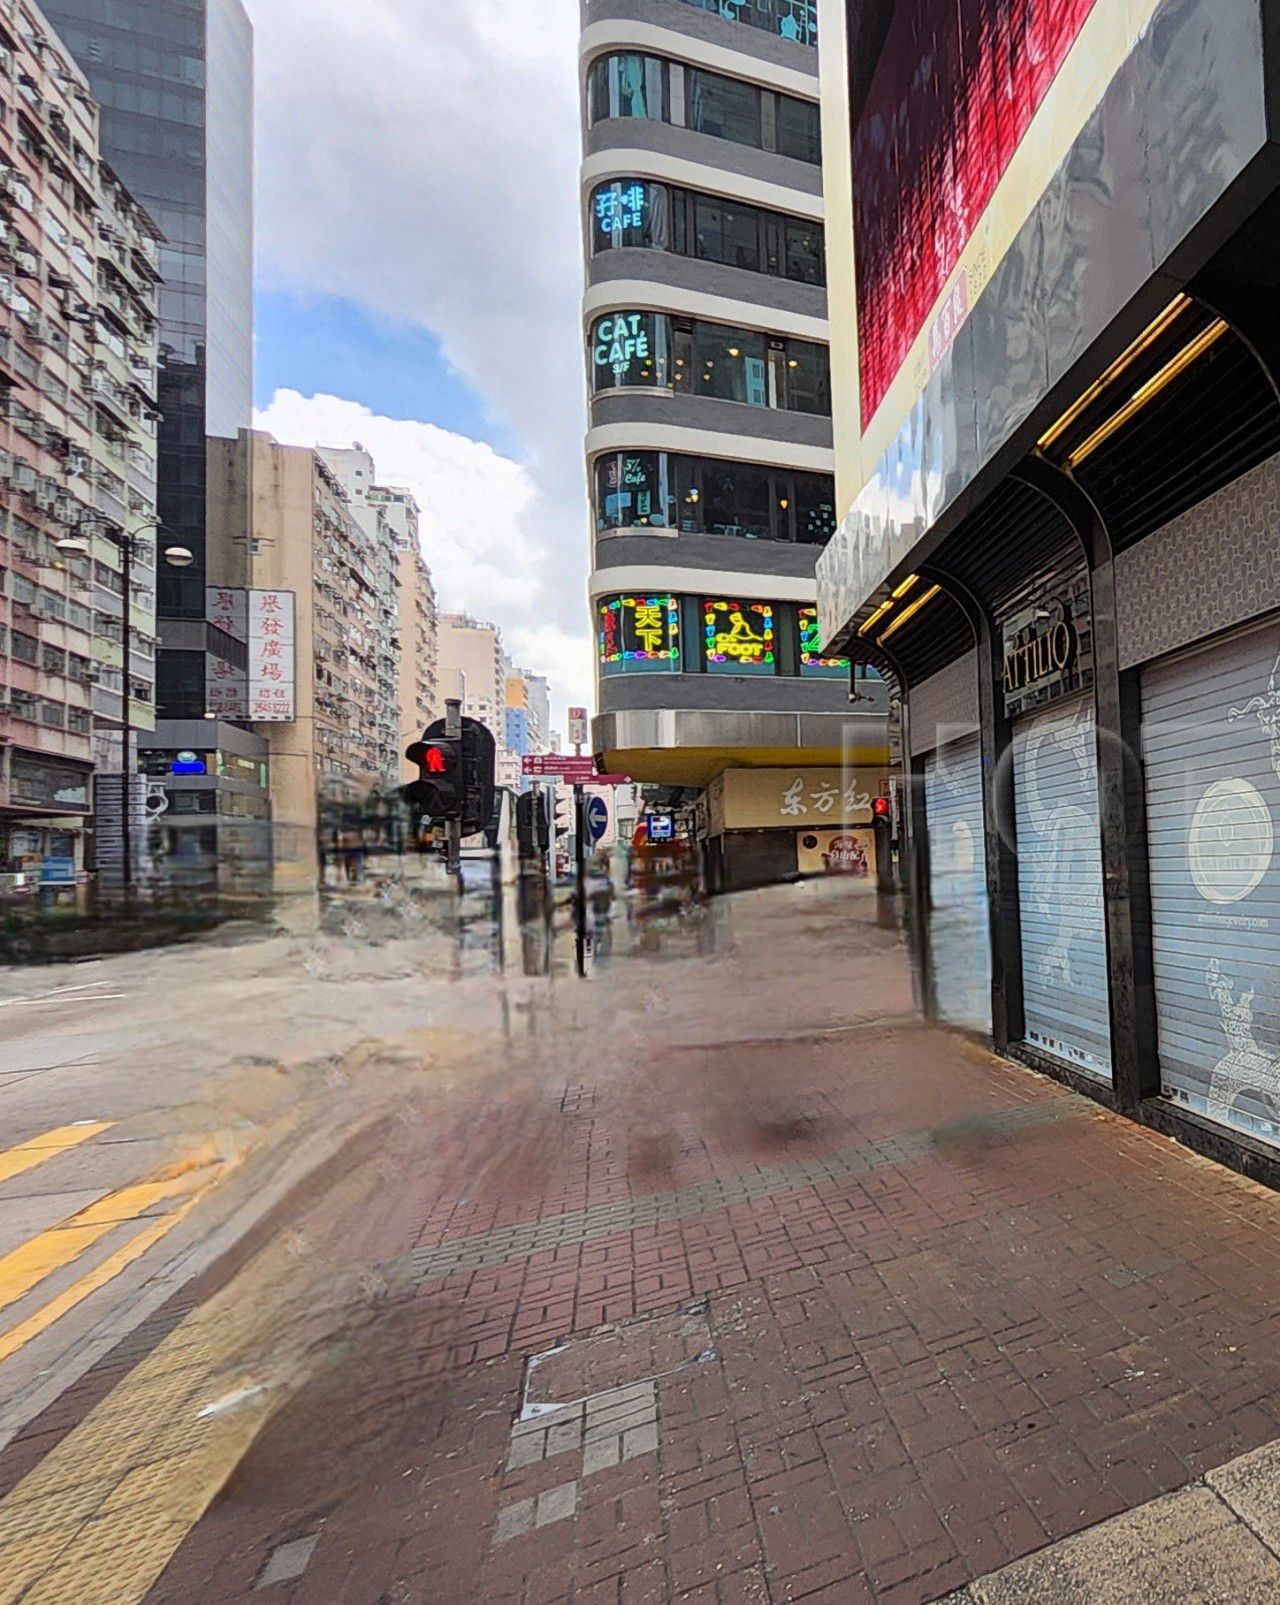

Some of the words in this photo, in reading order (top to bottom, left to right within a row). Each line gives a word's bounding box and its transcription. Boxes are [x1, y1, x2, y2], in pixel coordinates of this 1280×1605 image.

[601, 212, 641, 232] CAFE
[598, 314, 641, 341] CAT
[634, 605, 663, 651] 天下
[715, 642, 764, 656] FOOT
[1003, 620, 1070, 694] ATTILIO
